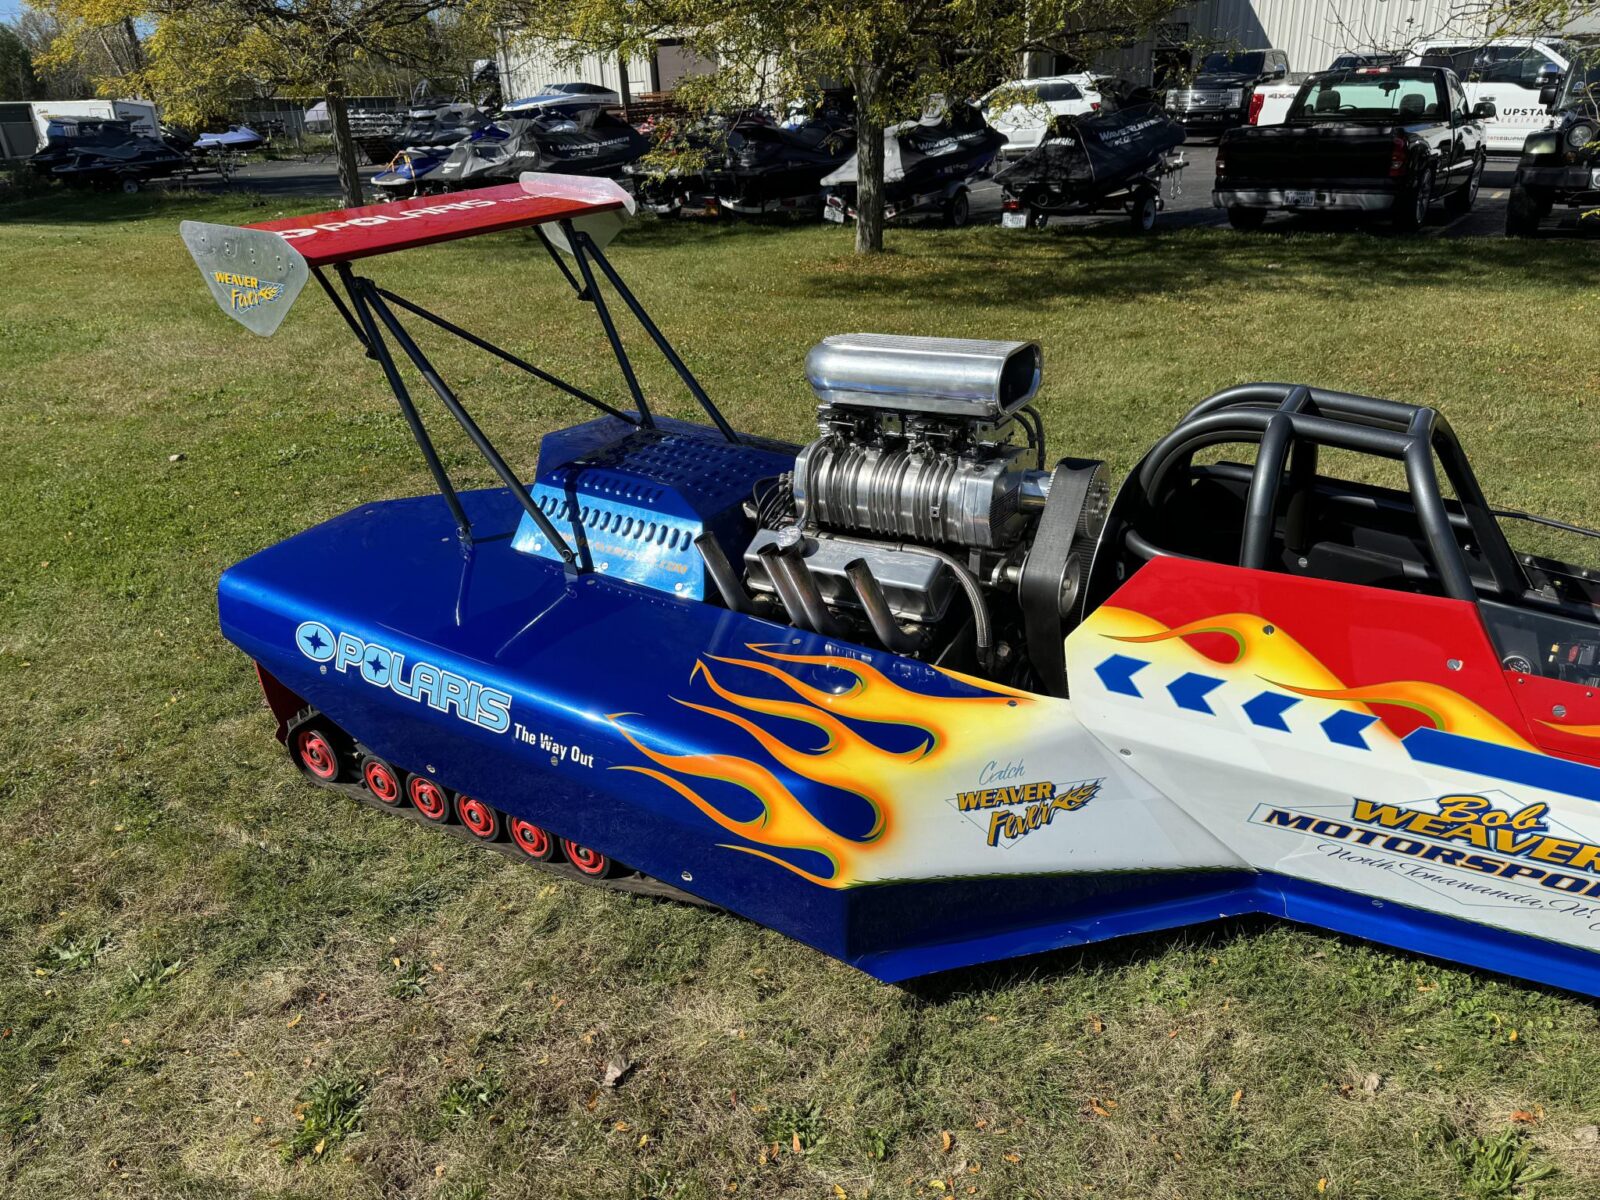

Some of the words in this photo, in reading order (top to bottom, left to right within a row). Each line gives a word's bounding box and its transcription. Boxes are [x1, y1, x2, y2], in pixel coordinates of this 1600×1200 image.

[1503, 108, 1544, 116] UPSTA
[312, 198, 496, 232] POLARIS
[215, 271, 260, 289] WEAVER
[335, 631, 513, 734] POLARIS
[514, 722, 536, 745] The
[540, 732, 567, 760] Way
[571, 745, 594, 768] Out
[979, 758, 1026, 785] Catch
[956, 781, 1056, 812] WEAVER
[986, 801, 1055, 847] Fever
[1436, 793, 1549, 833] Bob
[1317, 843, 1394, 872] North
